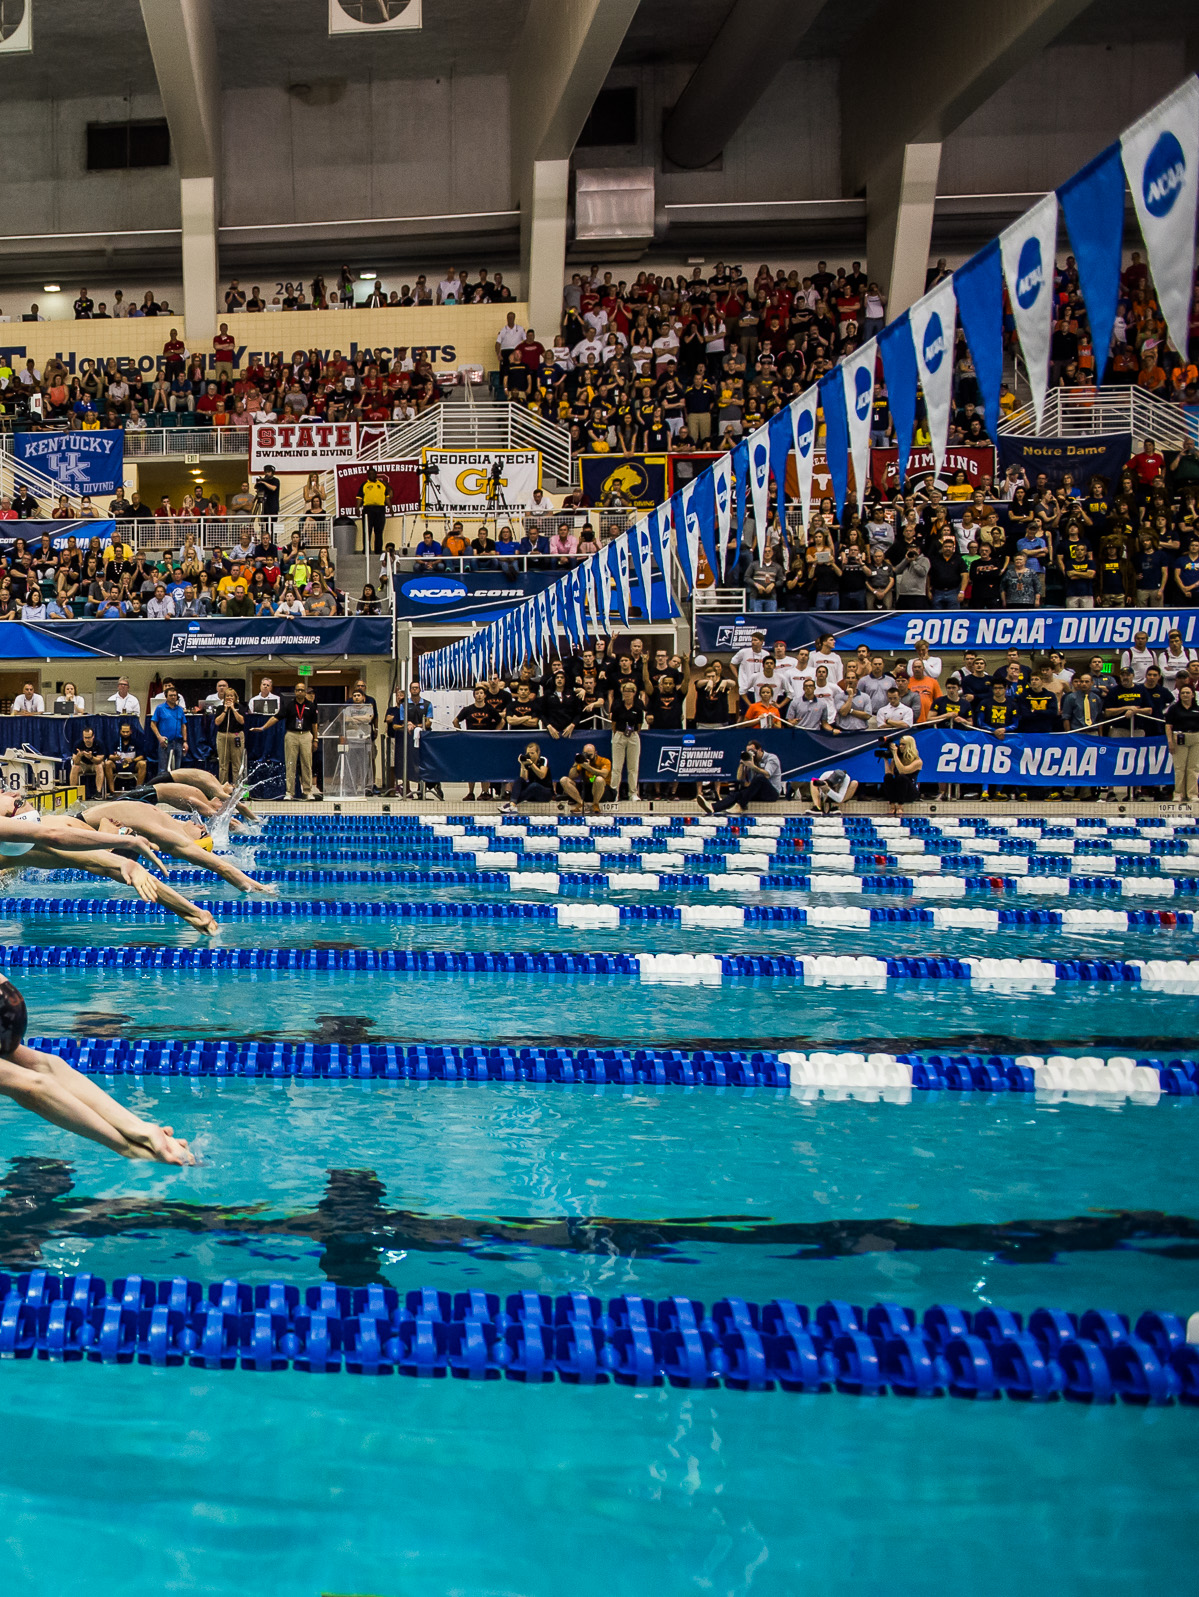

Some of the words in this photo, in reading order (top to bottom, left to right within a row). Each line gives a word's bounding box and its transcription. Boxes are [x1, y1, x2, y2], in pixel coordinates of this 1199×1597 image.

[257, 426, 352, 448] STATE
[25, 435, 114, 458] KENTUCKY
[1023, 446, 1065, 456] Notre
[1067, 446, 1107, 456] Dame
[187, 454, 198, 463] EXIT
[256, 449, 309, 458] SWIMMING
[311, 449, 318, 457] &
[319, 449, 353, 457] DIVING
[430, 454, 490, 465] GEORGIA
[494, 454, 535, 464] TECH
[46, 452, 91, 482] UK
[338, 465, 370, 477] CORNEL
[83, 481, 114, 493] DIVING
[392, 503, 419, 513] DIVING
[409, 588, 525, 598] NCAA.com
[904, 618, 970, 644] 2016
[1059, 616, 1179, 644] DIVISION
[1184, 616, 1196, 642] I
[187, 637, 227, 646] SWIMMING
[228, 637, 233, 645] &
[234, 637, 260, 645] DIVING
[261, 636, 321, 645] CHAMPIONSHIPS
[992, 708, 1006, 719] M
[681, 751, 724, 759] SWIMMING
[937, 743, 1012, 773] 2016
[680, 759, 685, 767] &
[686, 759, 713, 767] DIVING
[10, 772, 20, 791] 8
[39, 769, 49, 786] 9
